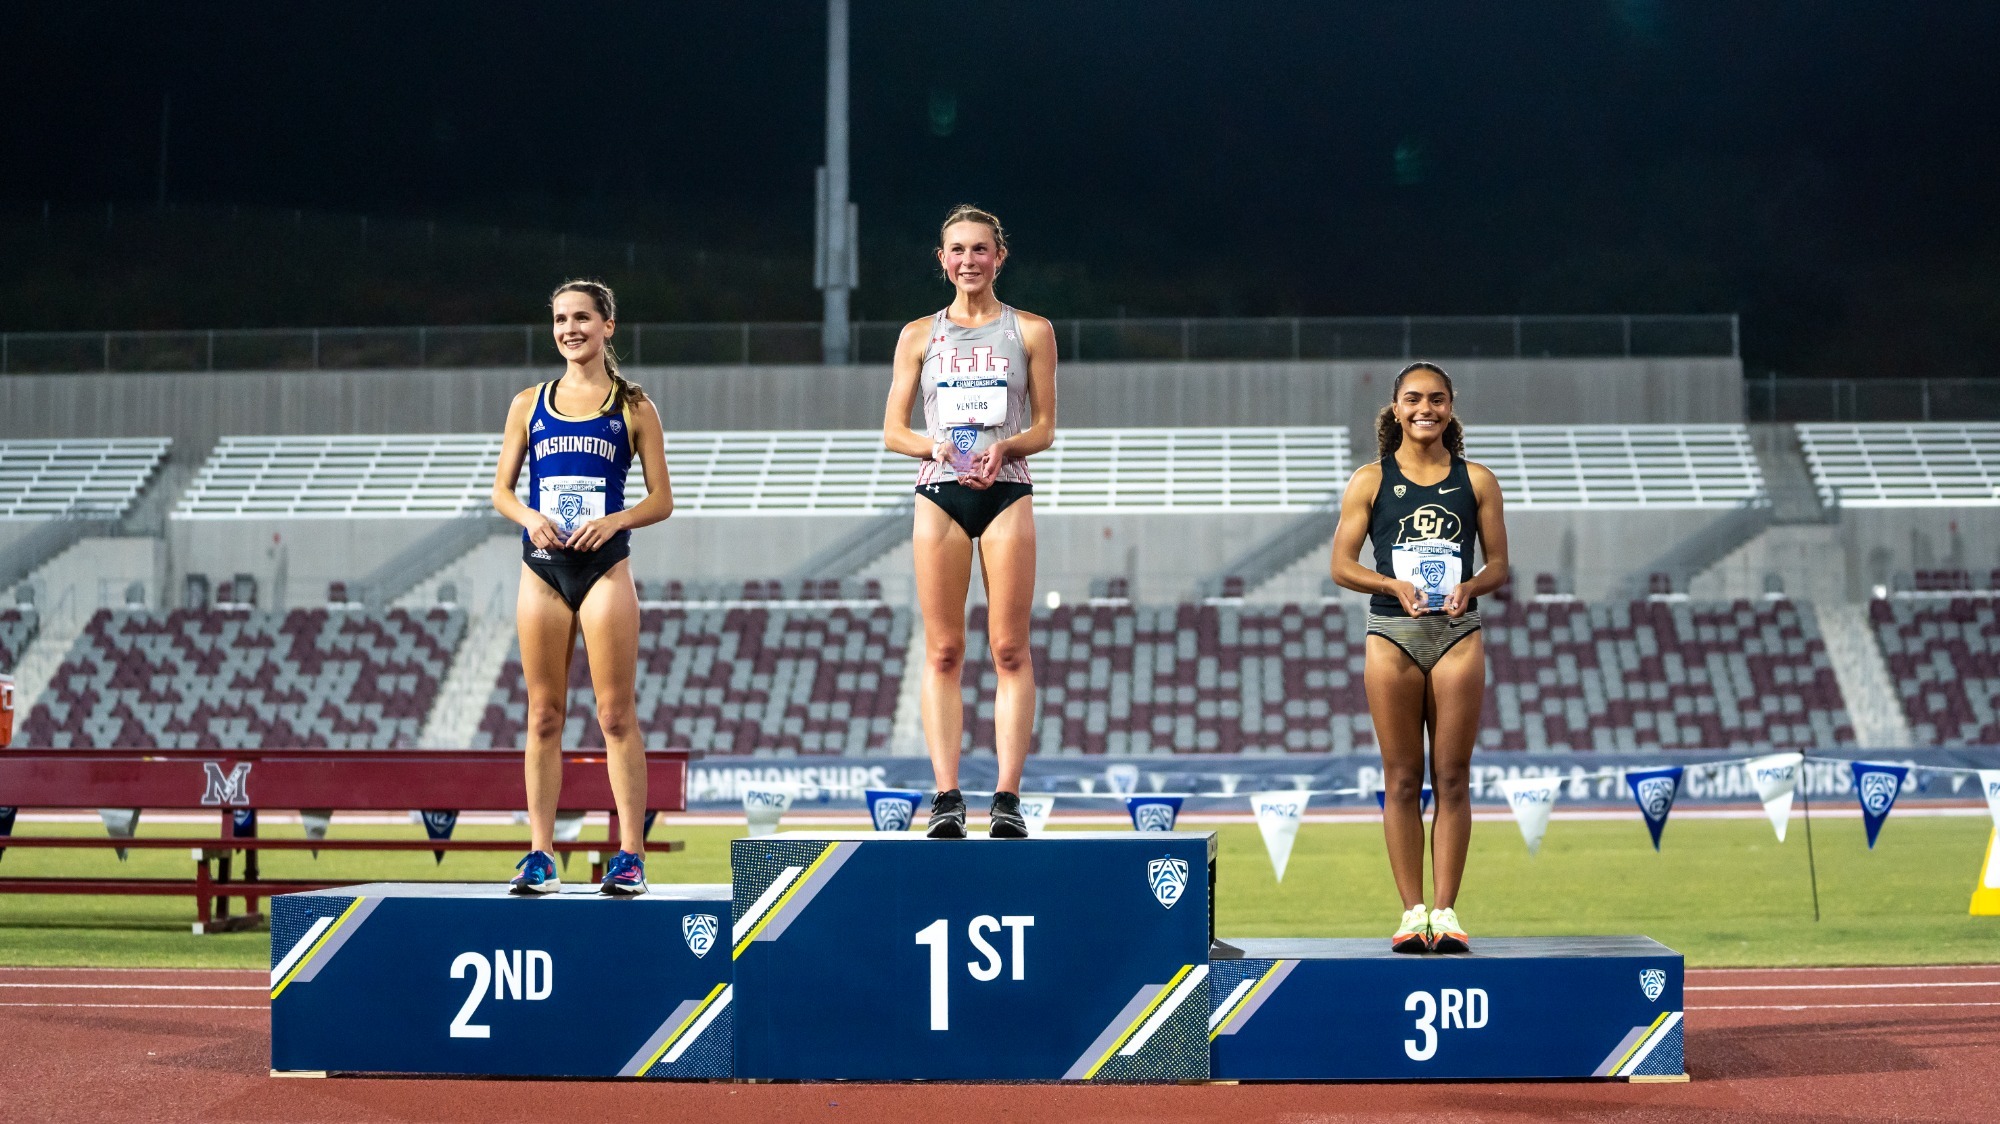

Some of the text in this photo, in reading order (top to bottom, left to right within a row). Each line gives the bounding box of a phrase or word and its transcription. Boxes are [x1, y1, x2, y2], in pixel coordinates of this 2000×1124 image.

[957, 402, 988, 411] VENTERS
[954, 430, 976, 444] PAC
[960, 441, 968, 449] 12
[534, 435, 617, 463] WASHINGTON
[561, 495, 581, 510] PAC
[565, 508, 574, 516] 12
[1413, 509, 1445, 538] CU
[1423, 563, 1444, 577] PAC
[202, 762, 252, 805] M
[1568, 765, 1590, 799] &
[1150, 860, 1187, 888] PAC
[1161, 885, 1176, 899] 12
[685, 915, 717, 938] PAC
[694, 937, 708, 950] 12
[915, 914, 1035, 1031] 1ST
[450, 949, 553, 1039] 2ND
[1647, 986, 1659, 996] 12
[1404, 988, 1489, 1062] 3RD
